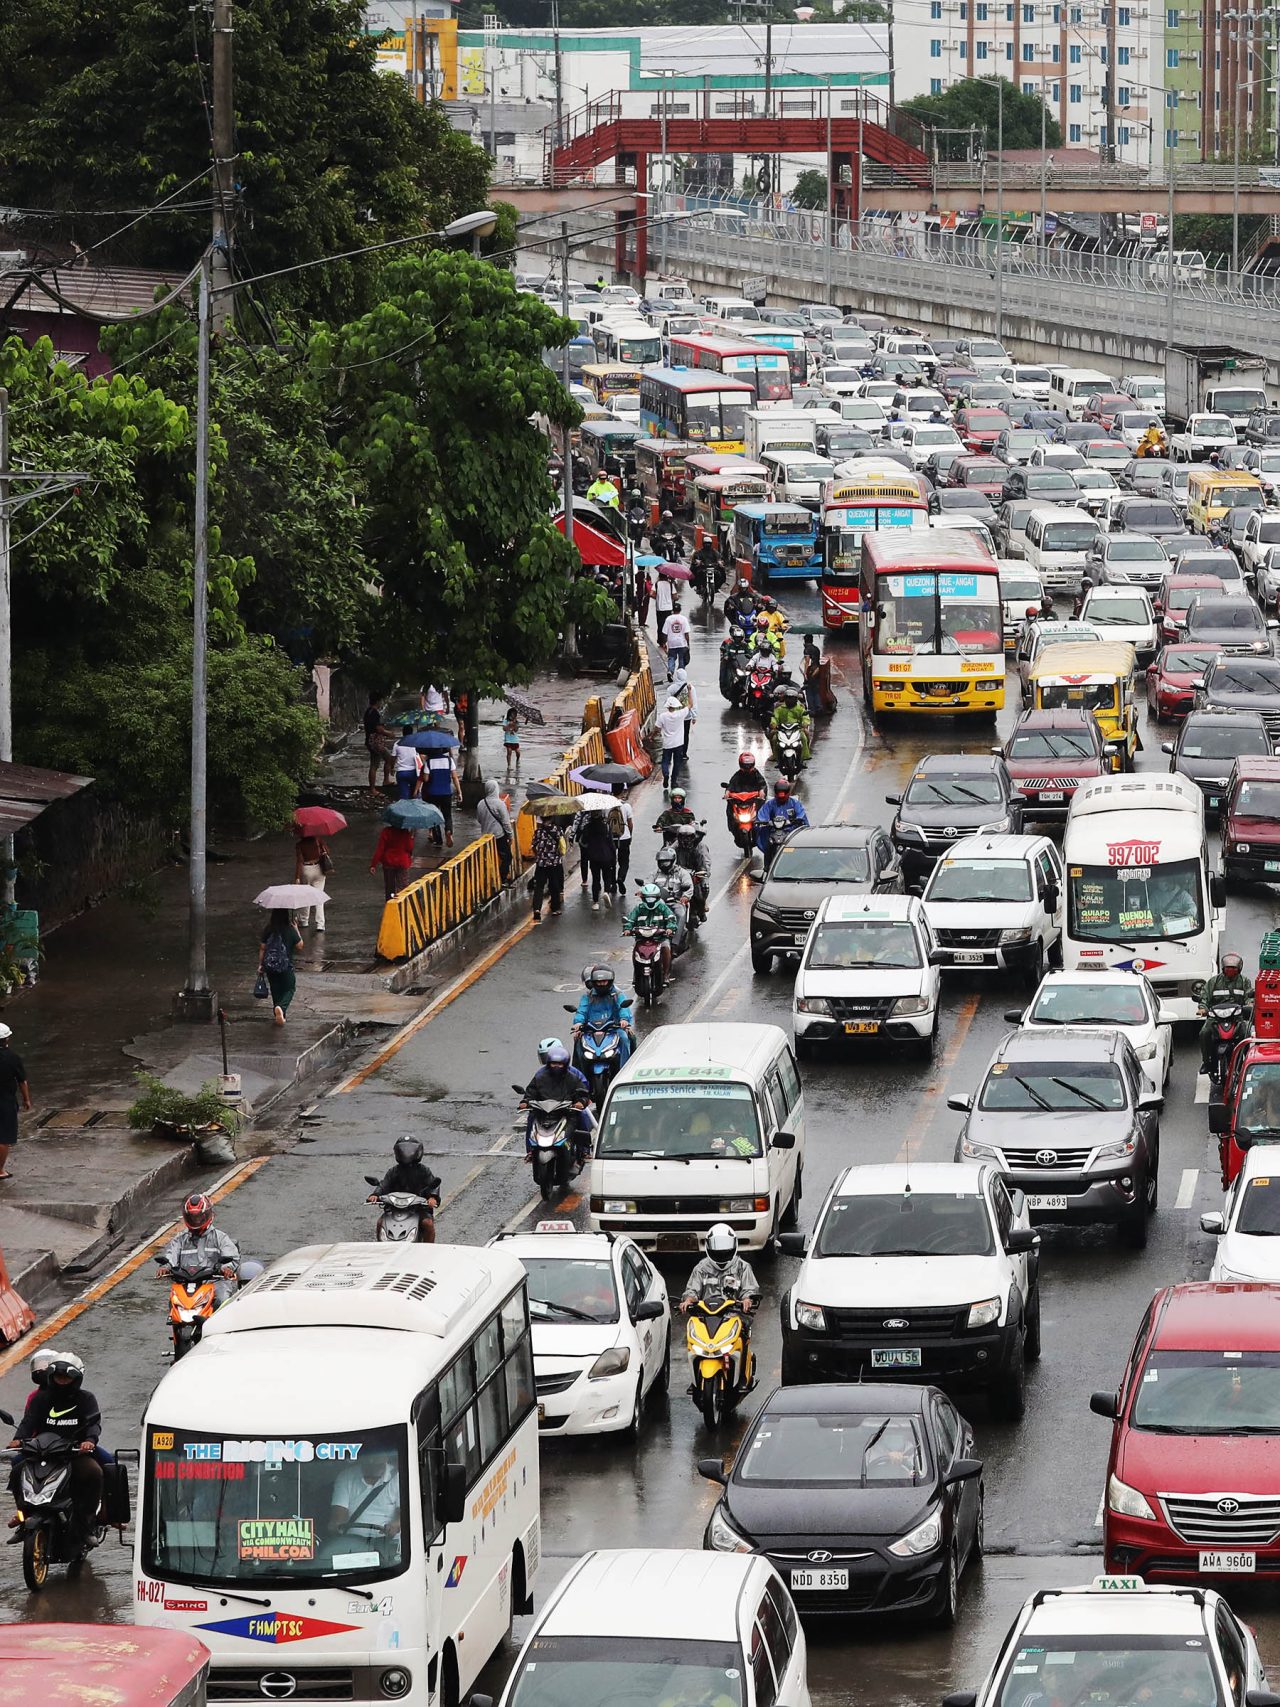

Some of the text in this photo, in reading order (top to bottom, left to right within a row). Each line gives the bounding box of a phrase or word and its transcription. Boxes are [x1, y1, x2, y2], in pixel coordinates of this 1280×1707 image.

[1119, 910, 1153, 925] BUENDIA
[637, 1067, 725, 1077] UVT 844
[629, 1085, 696, 1096] UV Express Service
[1046, 1197, 1067, 1207] 4893
[540, 1223, 570, 1231] TAXI
[46, 1417, 78, 1426] LOS ANGELES
[184, 1443, 222, 1460] THE
[315, 1443, 363, 1461] CITY
[155, 1462, 245, 1480] AIR CONDITION
[255, 1537, 311, 1546] COMMONWEALTH
[1226, 1556, 1253, 1567] 9600
[792, 1574, 847, 1586] NDD 8350
[1099, 1579, 1137, 1589] TAXI
[137, 1580, 165, 1603] FH-027
[249, 1620, 304, 1636] FHMPTSC
